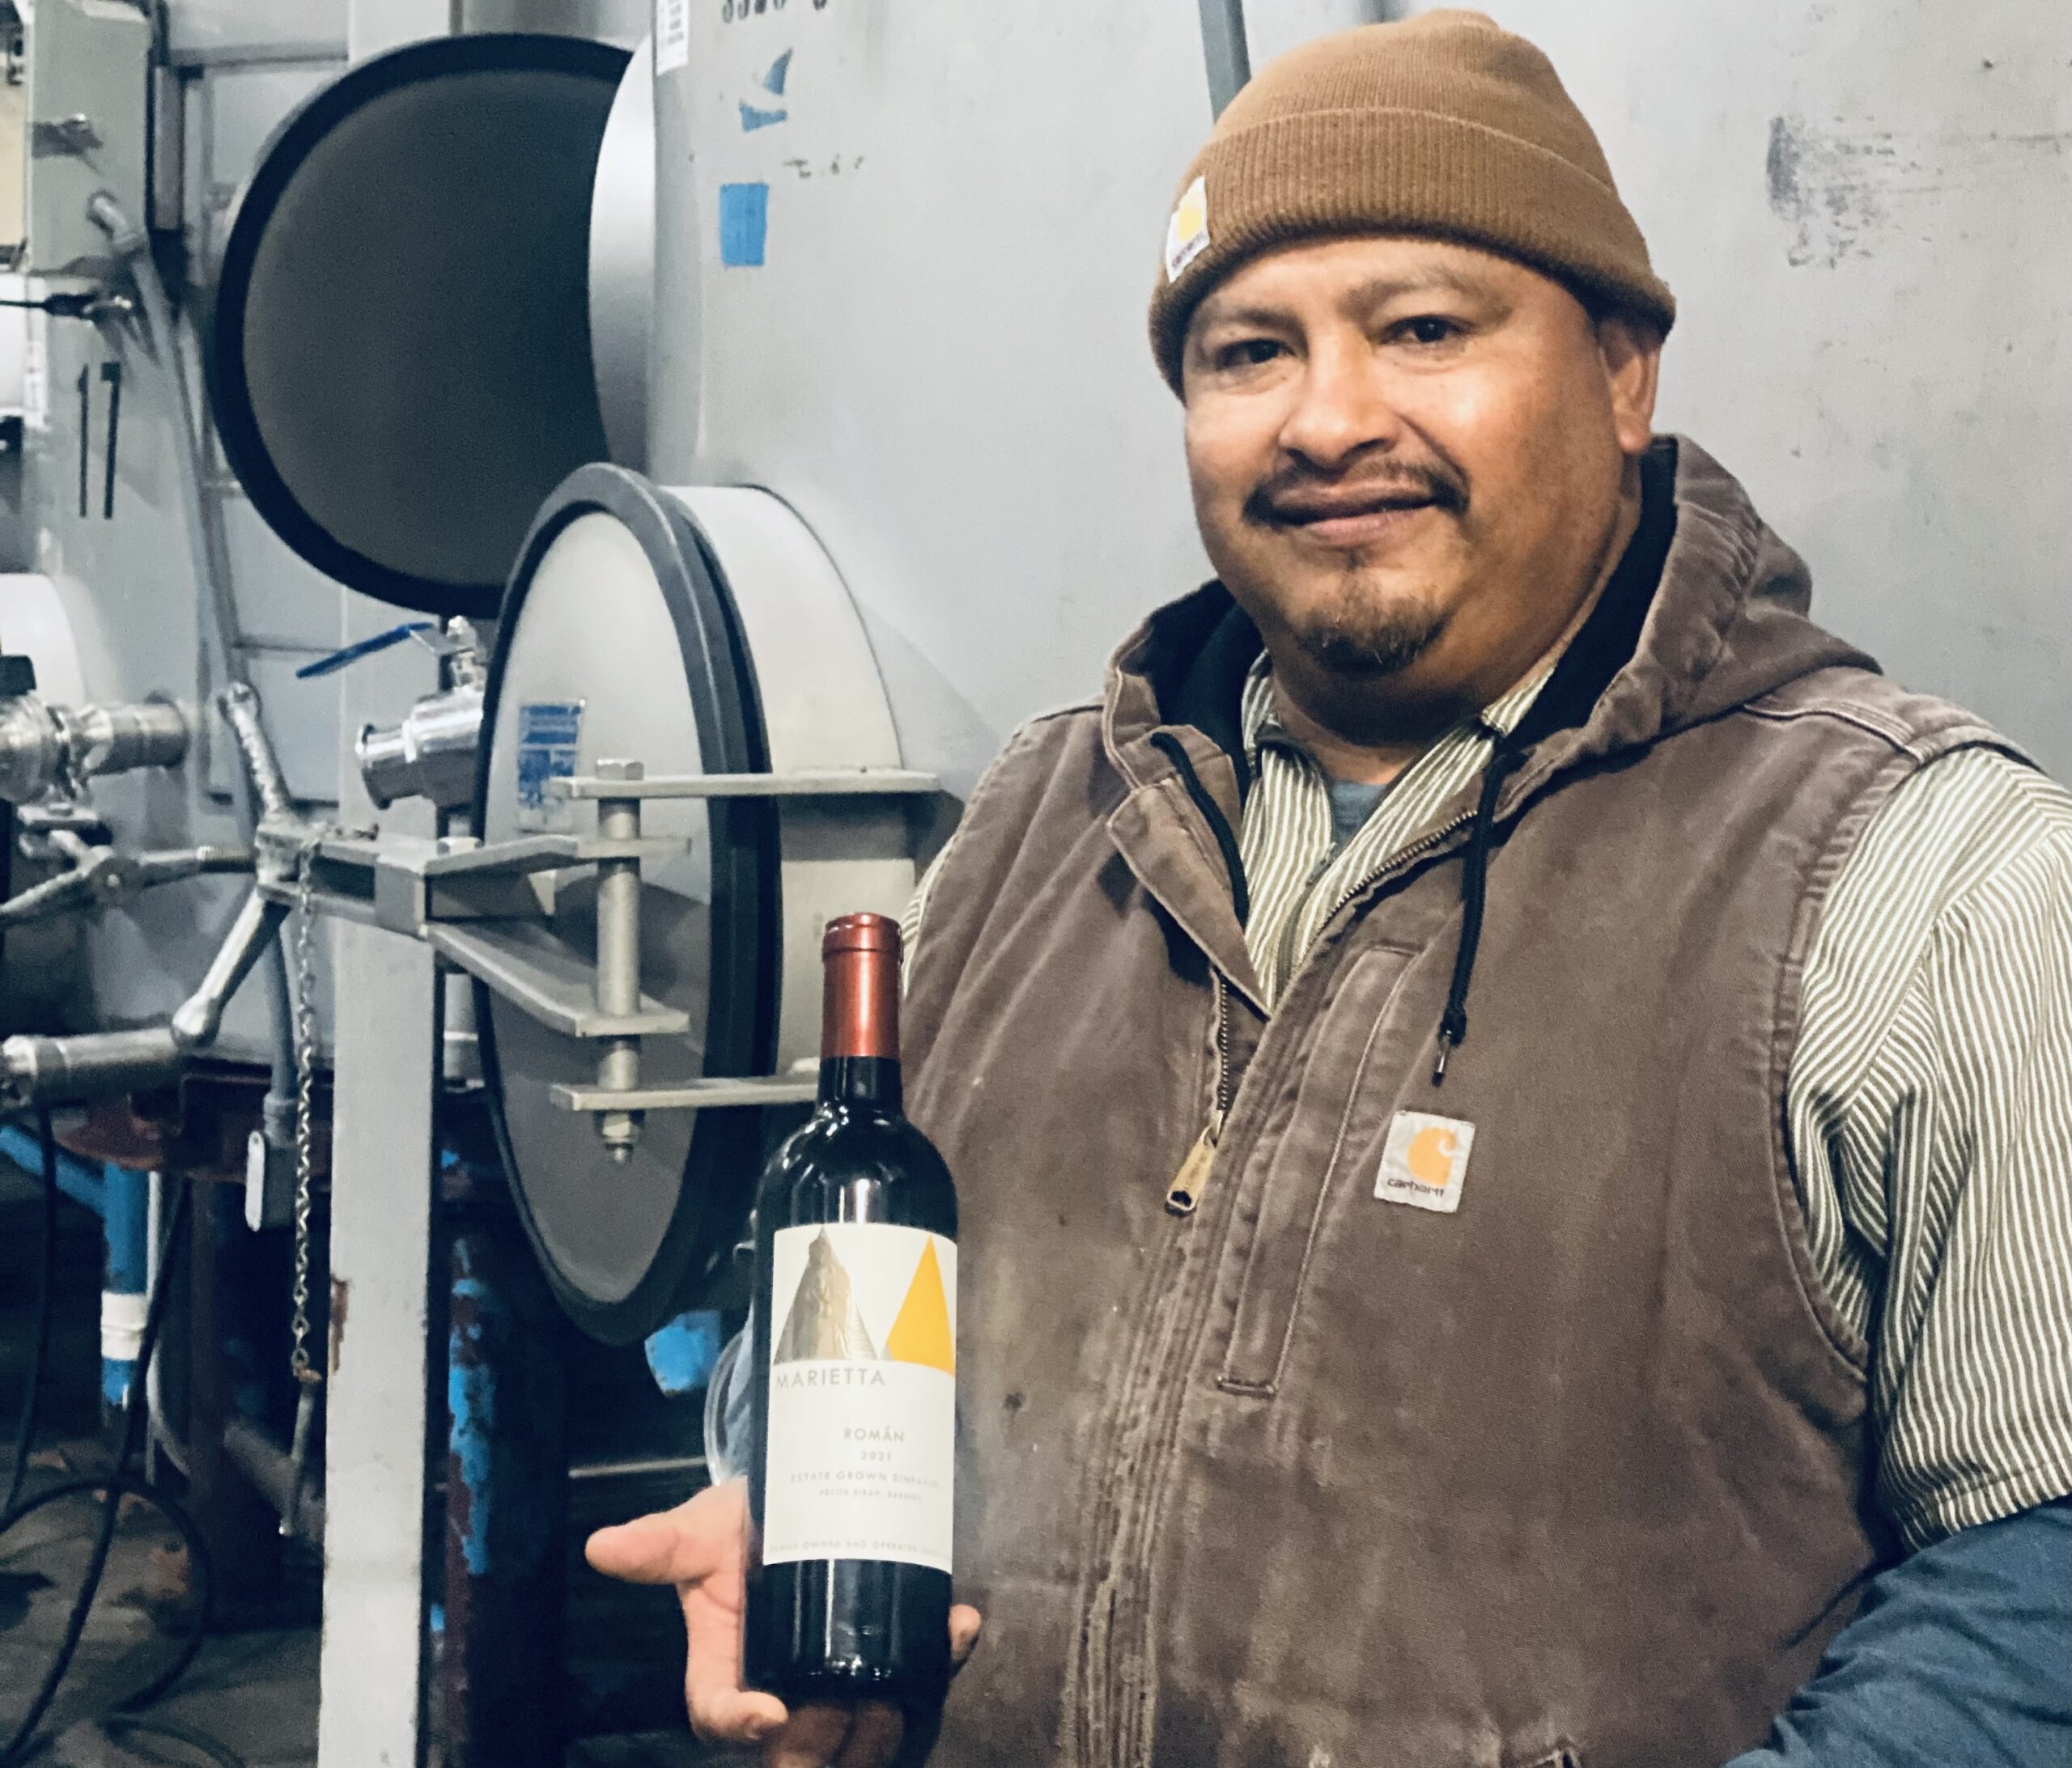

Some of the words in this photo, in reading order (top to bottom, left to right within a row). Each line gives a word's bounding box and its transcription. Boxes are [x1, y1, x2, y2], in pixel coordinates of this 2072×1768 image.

[775, 1367, 885, 1390] MARIETTA
[843, 1426, 905, 1443] ROMÁN
[860, 1451, 892, 1462] 2021
[790, 1471, 830, 1483] ESTATE
[836, 1470, 887, 1482] GROWN
